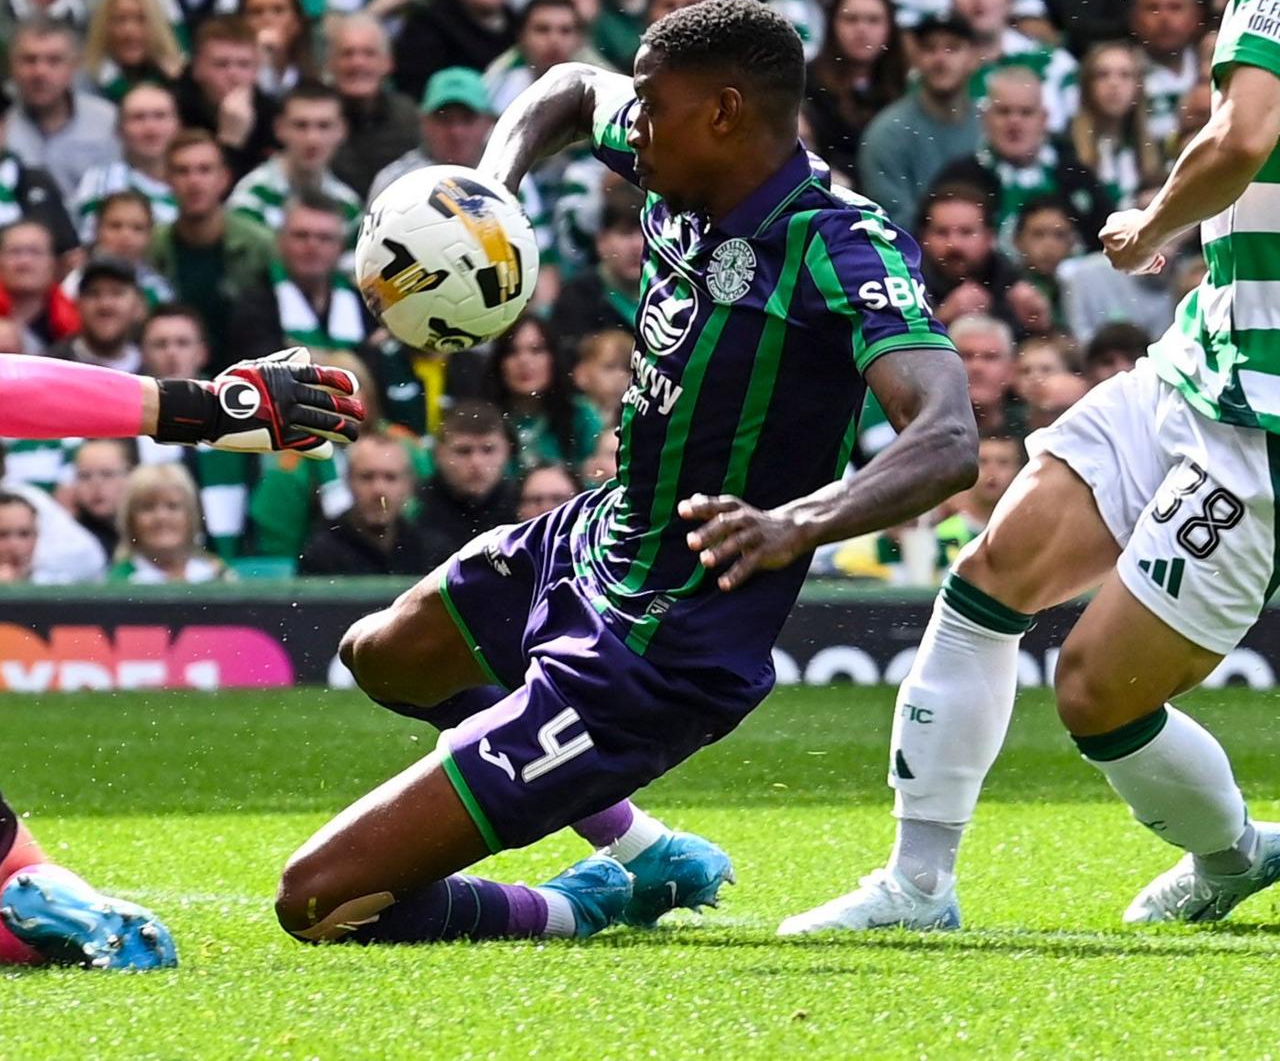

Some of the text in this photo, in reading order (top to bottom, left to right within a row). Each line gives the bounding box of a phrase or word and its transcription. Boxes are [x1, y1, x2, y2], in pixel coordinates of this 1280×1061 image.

[858, 276, 933, 316] SBK
[631, 350, 683, 415] evvy
[1151, 461, 1245, 560] 38
[521, 706, 595, 784] 4
